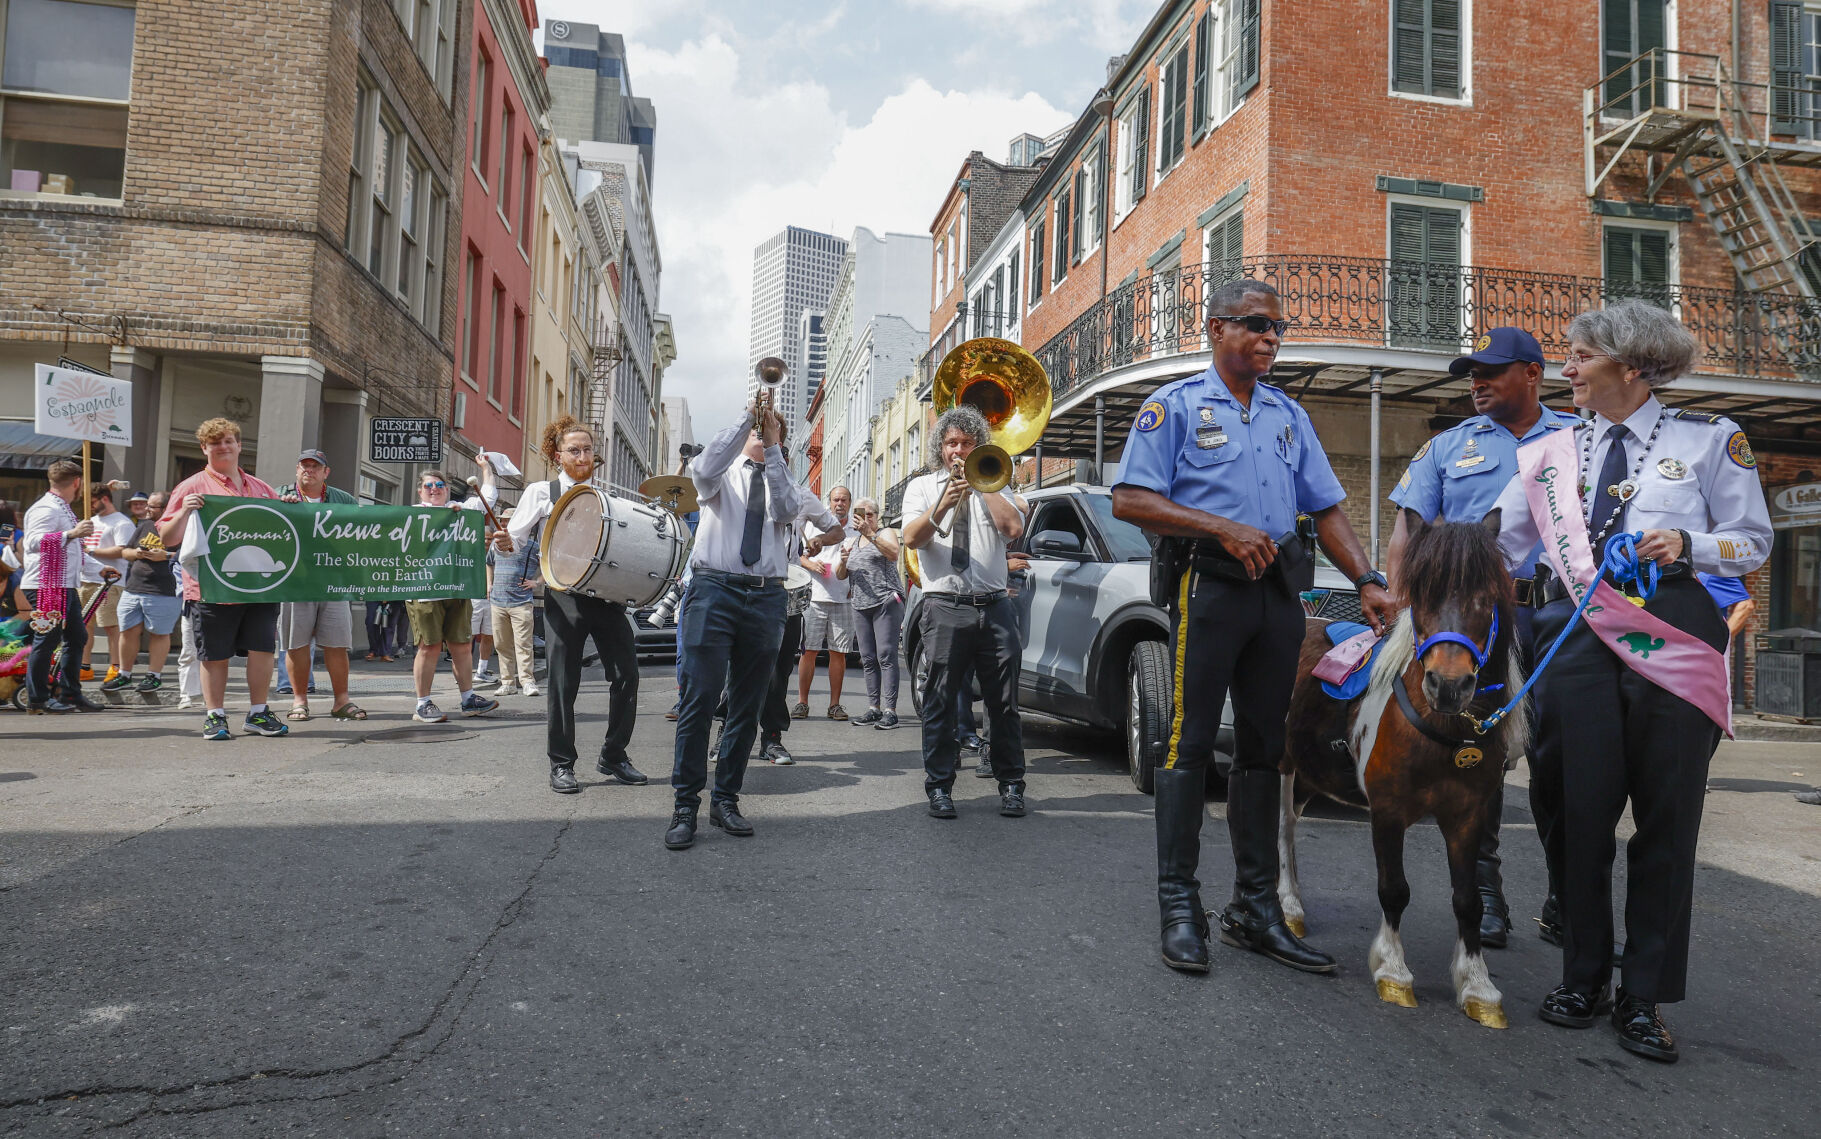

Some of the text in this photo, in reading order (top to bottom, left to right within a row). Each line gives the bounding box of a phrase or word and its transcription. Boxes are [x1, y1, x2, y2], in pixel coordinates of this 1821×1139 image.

[47, 387, 125, 424] Espagnole
[374, 420, 430, 432] CRESCENT
[374, 432, 407, 445] CITY
[374, 446, 415, 460] BOOKS
[1535, 466, 1563, 526] Grand
[1786, 491, 1793, 504] A
[216, 525, 291, 544] Brennan's
[312, 510, 478, 552] Krewe of Turtles
[313, 553, 342, 566] The
[346, 552, 400, 567] Slowest
[404, 553, 453, 568] Second
[372, 568, 433, 581] on Earth
[327, 585, 366, 595] Parading
[367, 585, 375, 593] to
[377, 585, 390, 593] the
[391, 583, 432, 593] Brennan's
